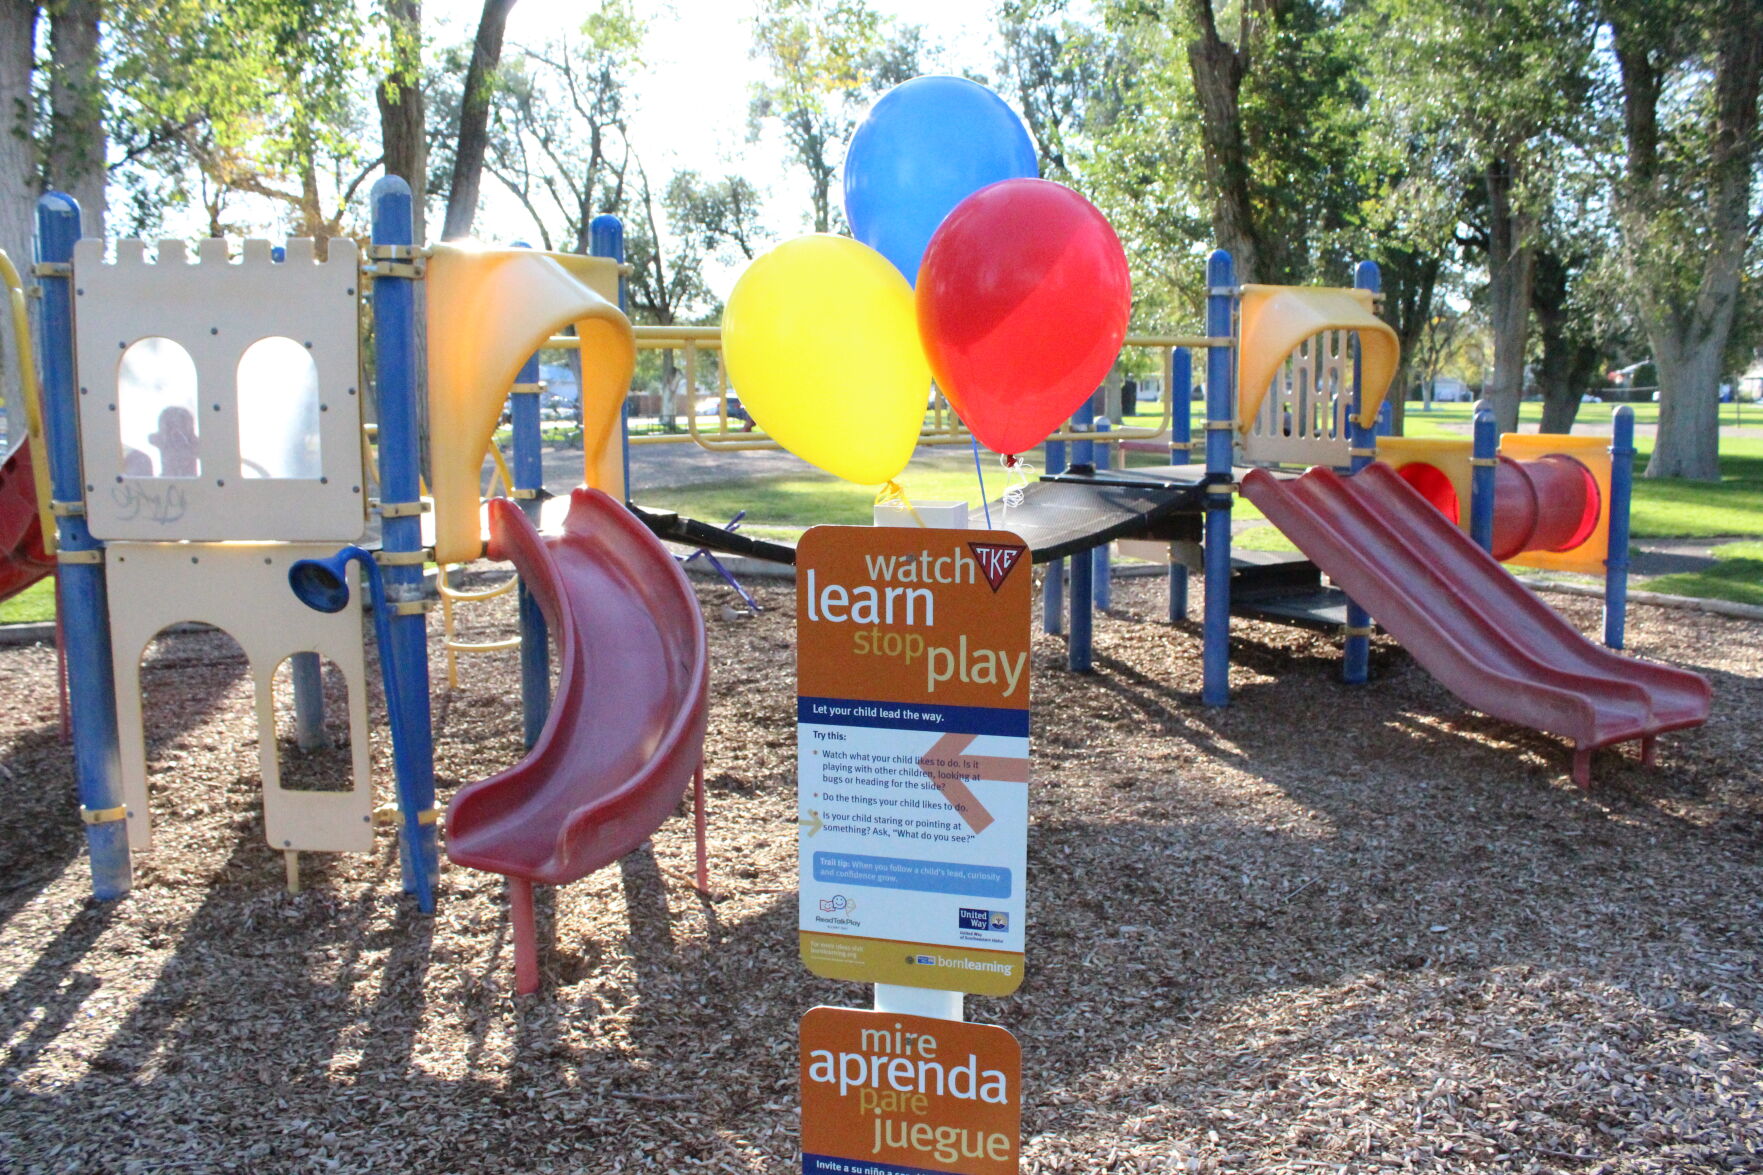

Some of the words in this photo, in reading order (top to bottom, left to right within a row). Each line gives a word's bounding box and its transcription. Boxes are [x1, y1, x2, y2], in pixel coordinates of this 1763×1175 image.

[865, 547, 975, 584] watch
[976, 548, 1018, 579] TKE
[807, 568, 934, 626] learn
[853, 626, 924, 665] stop
[927, 634, 1027, 697] play
[812, 704, 828, 714] Let
[829, 706, 852, 717] your
[853, 707, 877, 717] child
[879, 708, 901, 719] lead
[902, 710, 920, 720] the
[921, 713, 945, 723] way.
[812, 730, 826, 741] Try
[827, 731, 847, 741] this:
[822, 749, 848, 760] Watch
[849, 751, 870, 761] what
[871, 755, 891, 763] your
[892, 754, 913, 764] child
[914, 755, 935, 766] likes
[936, 759, 946, 767] to
[947, 758, 961, 768] do.
[963, 760, 971, 769] Is
[972, 760, 979, 769] it
[822, 762, 853, 774] playing
[854, 764, 873, 774] with
[874, 765, 897, 775] other
[898, 767, 936, 780] children,
[938, 771, 970, 782] looking
[972, 773, 981, 781] at
[822, 774, 843, 785] bugs
[855, 776, 890, 788] heading
[891, 778, 903, 788] for
[904, 779, 919, 789] the
[920, 781, 946, 791] slide?
[822, 792, 834, 801] Do
[835, 793, 850, 802] the
[851, 794, 878, 806] things
[879, 798, 898, 807] your
[899, 798, 920, 808] child
[922, 799, 942, 810] likes
[944, 803, 953, 811] to
[954, 803, 969, 812] do.
[822, 811, 830, 819] Is
[831, 813, 851, 821] your
[851, 813, 872, 823] child
[873, 815, 903, 827] staring
[915, 819, 952, 831] pointing
[953, 822, 962, 830] at
[823, 824, 871, 836] something?
[872, 827, 891, 838] Ask,
[920, 831, 932, 840] do
[933, 834, 950, 842] you
[820, 857, 836, 866] Trail
[837, 859, 850, 869] tip:
[851, 860, 873, 869] When
[874, 863, 889, 872] you
[889, 863, 913, 873] follow
[920, 866, 946, 877] child's
[967, 871, 1001, 882] curiosity
[960, 910, 987, 920] United
[970, 918, 987, 930] Way
[938, 956, 1013, 976] bornlearning
[860, 1023, 937, 1059] mire
[808, 1050, 1008, 1105] aprenda
[859, 1087, 930, 1116] pare
[871, 1107, 1011, 1164] juegue
[816, 1160, 842, 1172] Invite
[843, 1165, 850, 1173] a
[851, 1166, 863, 1174] su
[864, 1167, 885, 1175] niño
